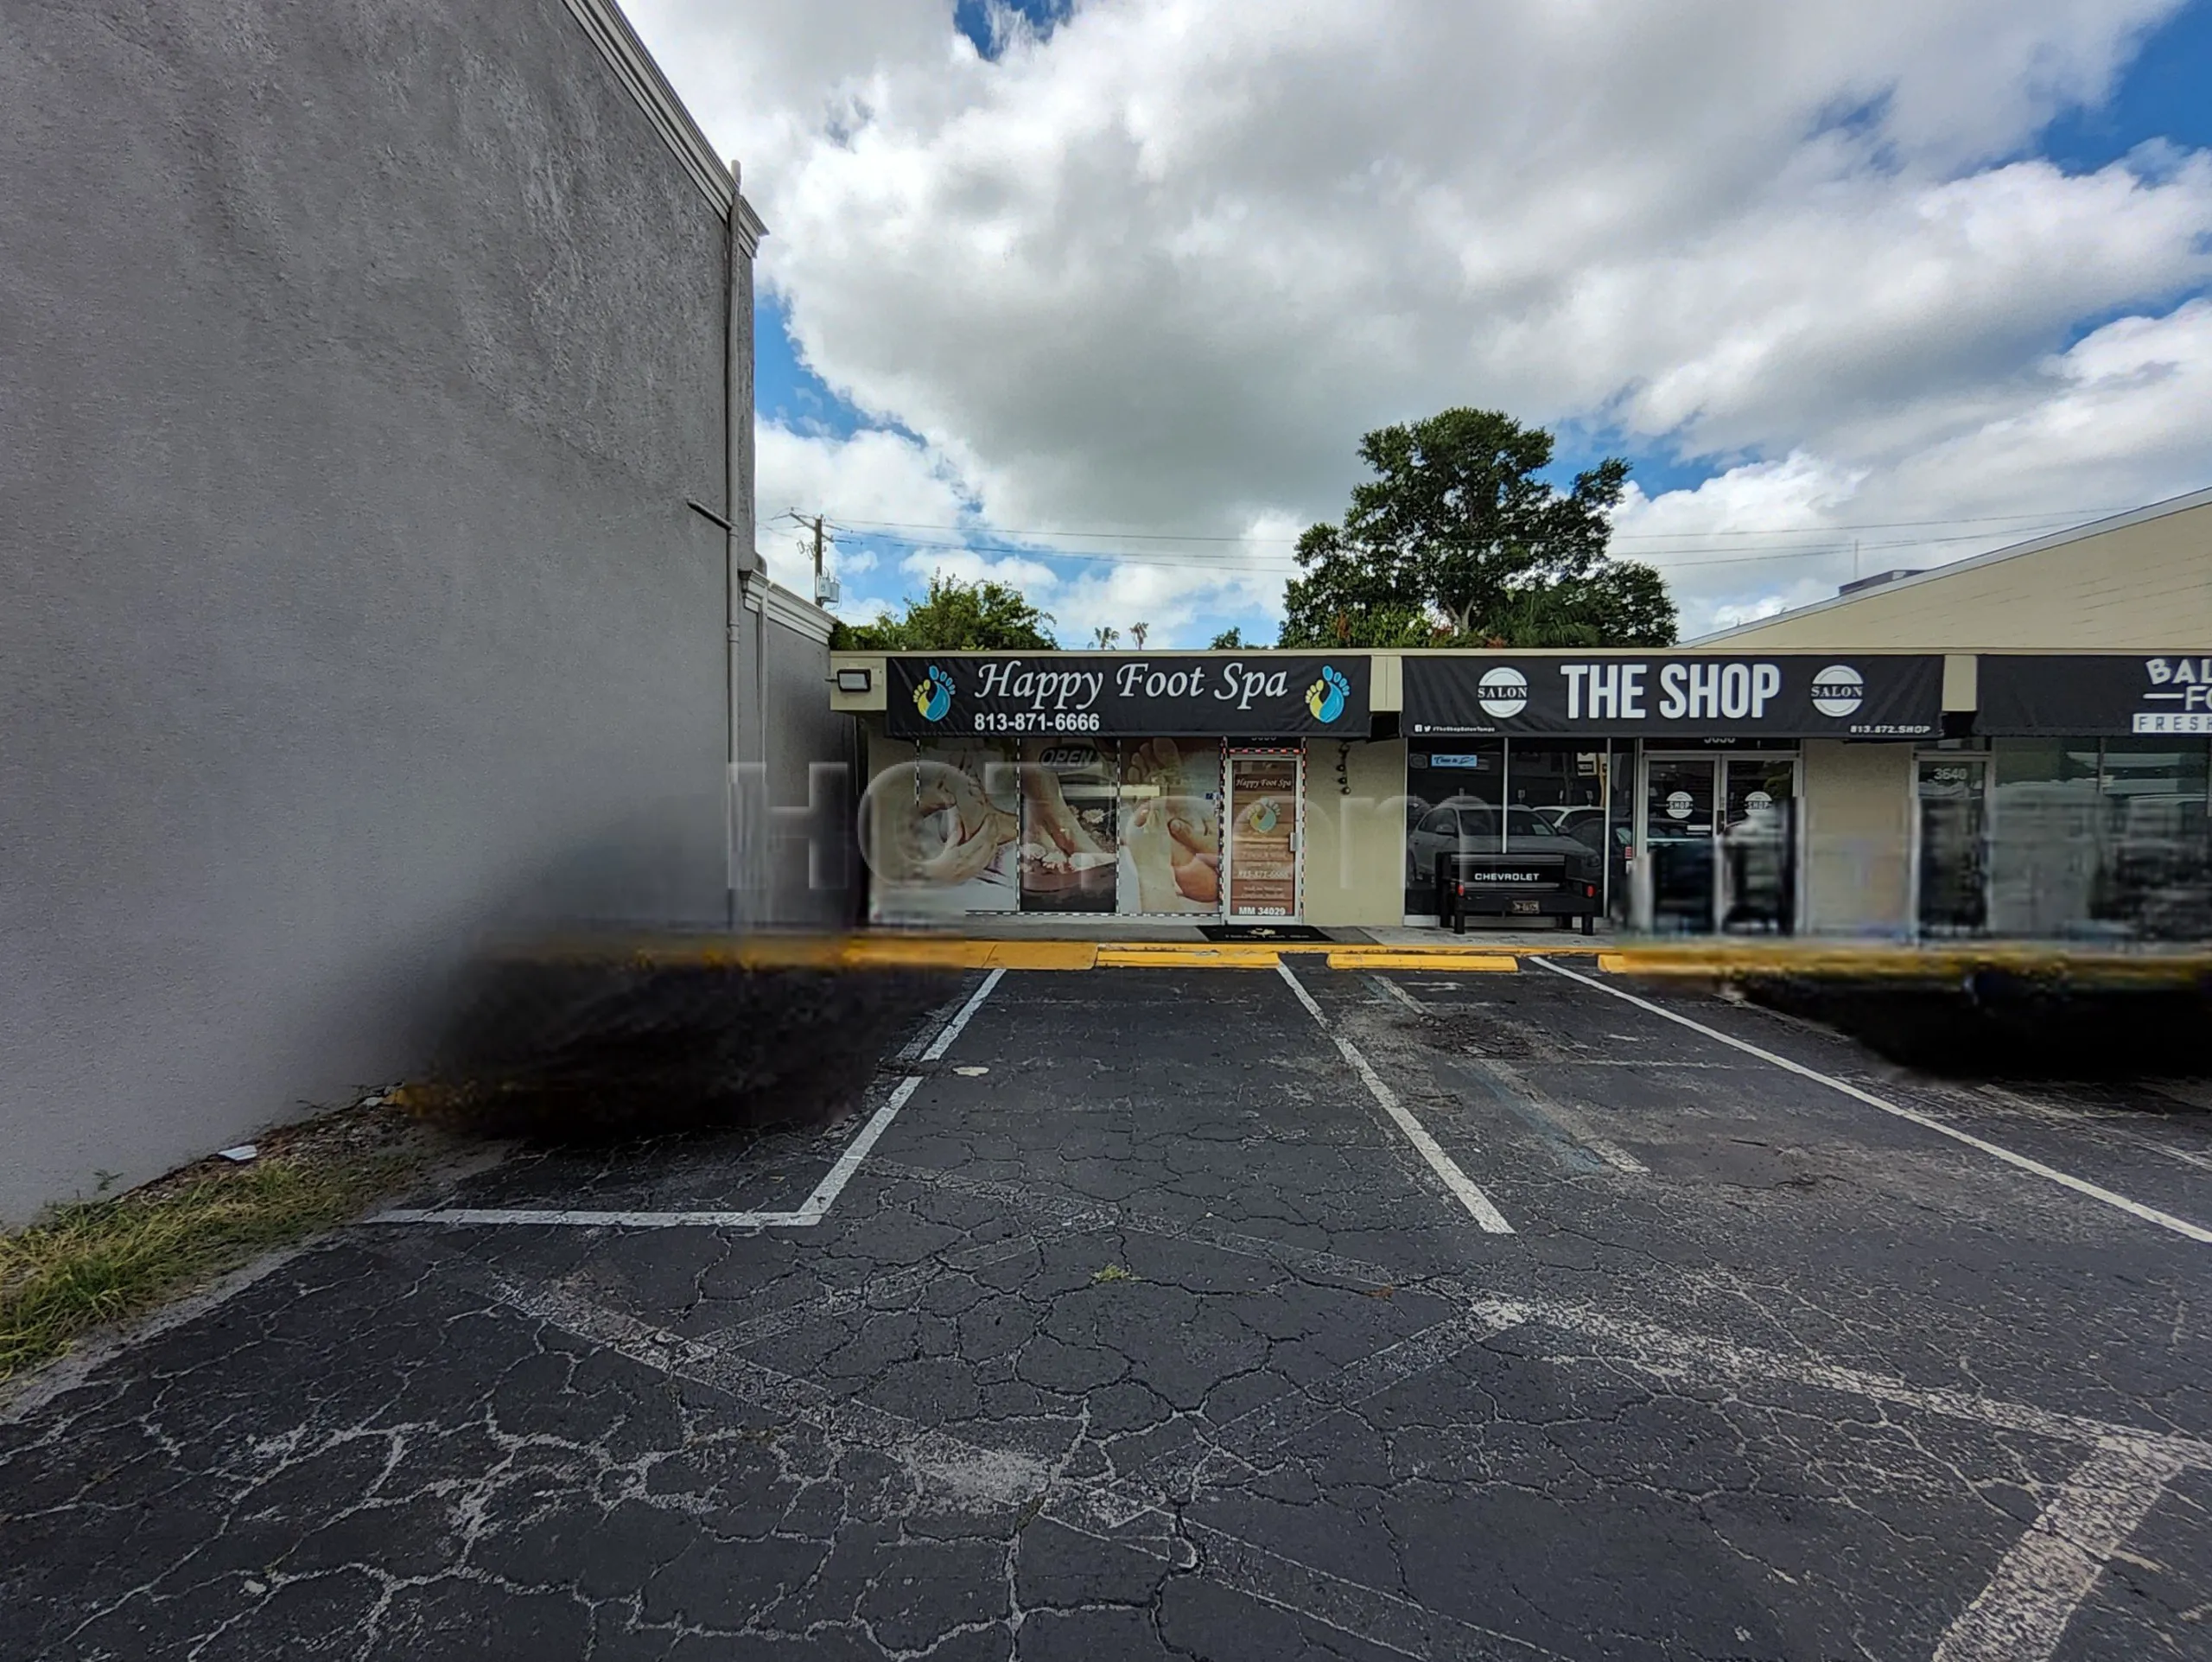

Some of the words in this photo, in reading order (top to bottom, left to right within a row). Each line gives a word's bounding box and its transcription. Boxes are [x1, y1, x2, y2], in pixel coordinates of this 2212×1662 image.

[2145, 658, 2212, 685] BAL
[974, 659, 1103, 710] Happy
[1116, 662, 1205, 697] Foot
[1213, 661, 1288, 710] Spa
[1560, 665, 1648, 719] THE
[1659, 663, 1781, 719] SHOP
[1477, 687, 1529, 698] SALON
[1810, 685, 1864, 698] SALON
[974, 712, 1100, 731] 813-871-6666
[1850, 725, 1930, 734] 813.872.SHOP
[1040, 749, 1094, 767] OPEN
[1933, 767, 1968, 780] 3640
[1236, 778, 1259, 788] Happy
[1278, 779, 1292, 788] Spa
[1257, 907, 1286, 915] 34029
